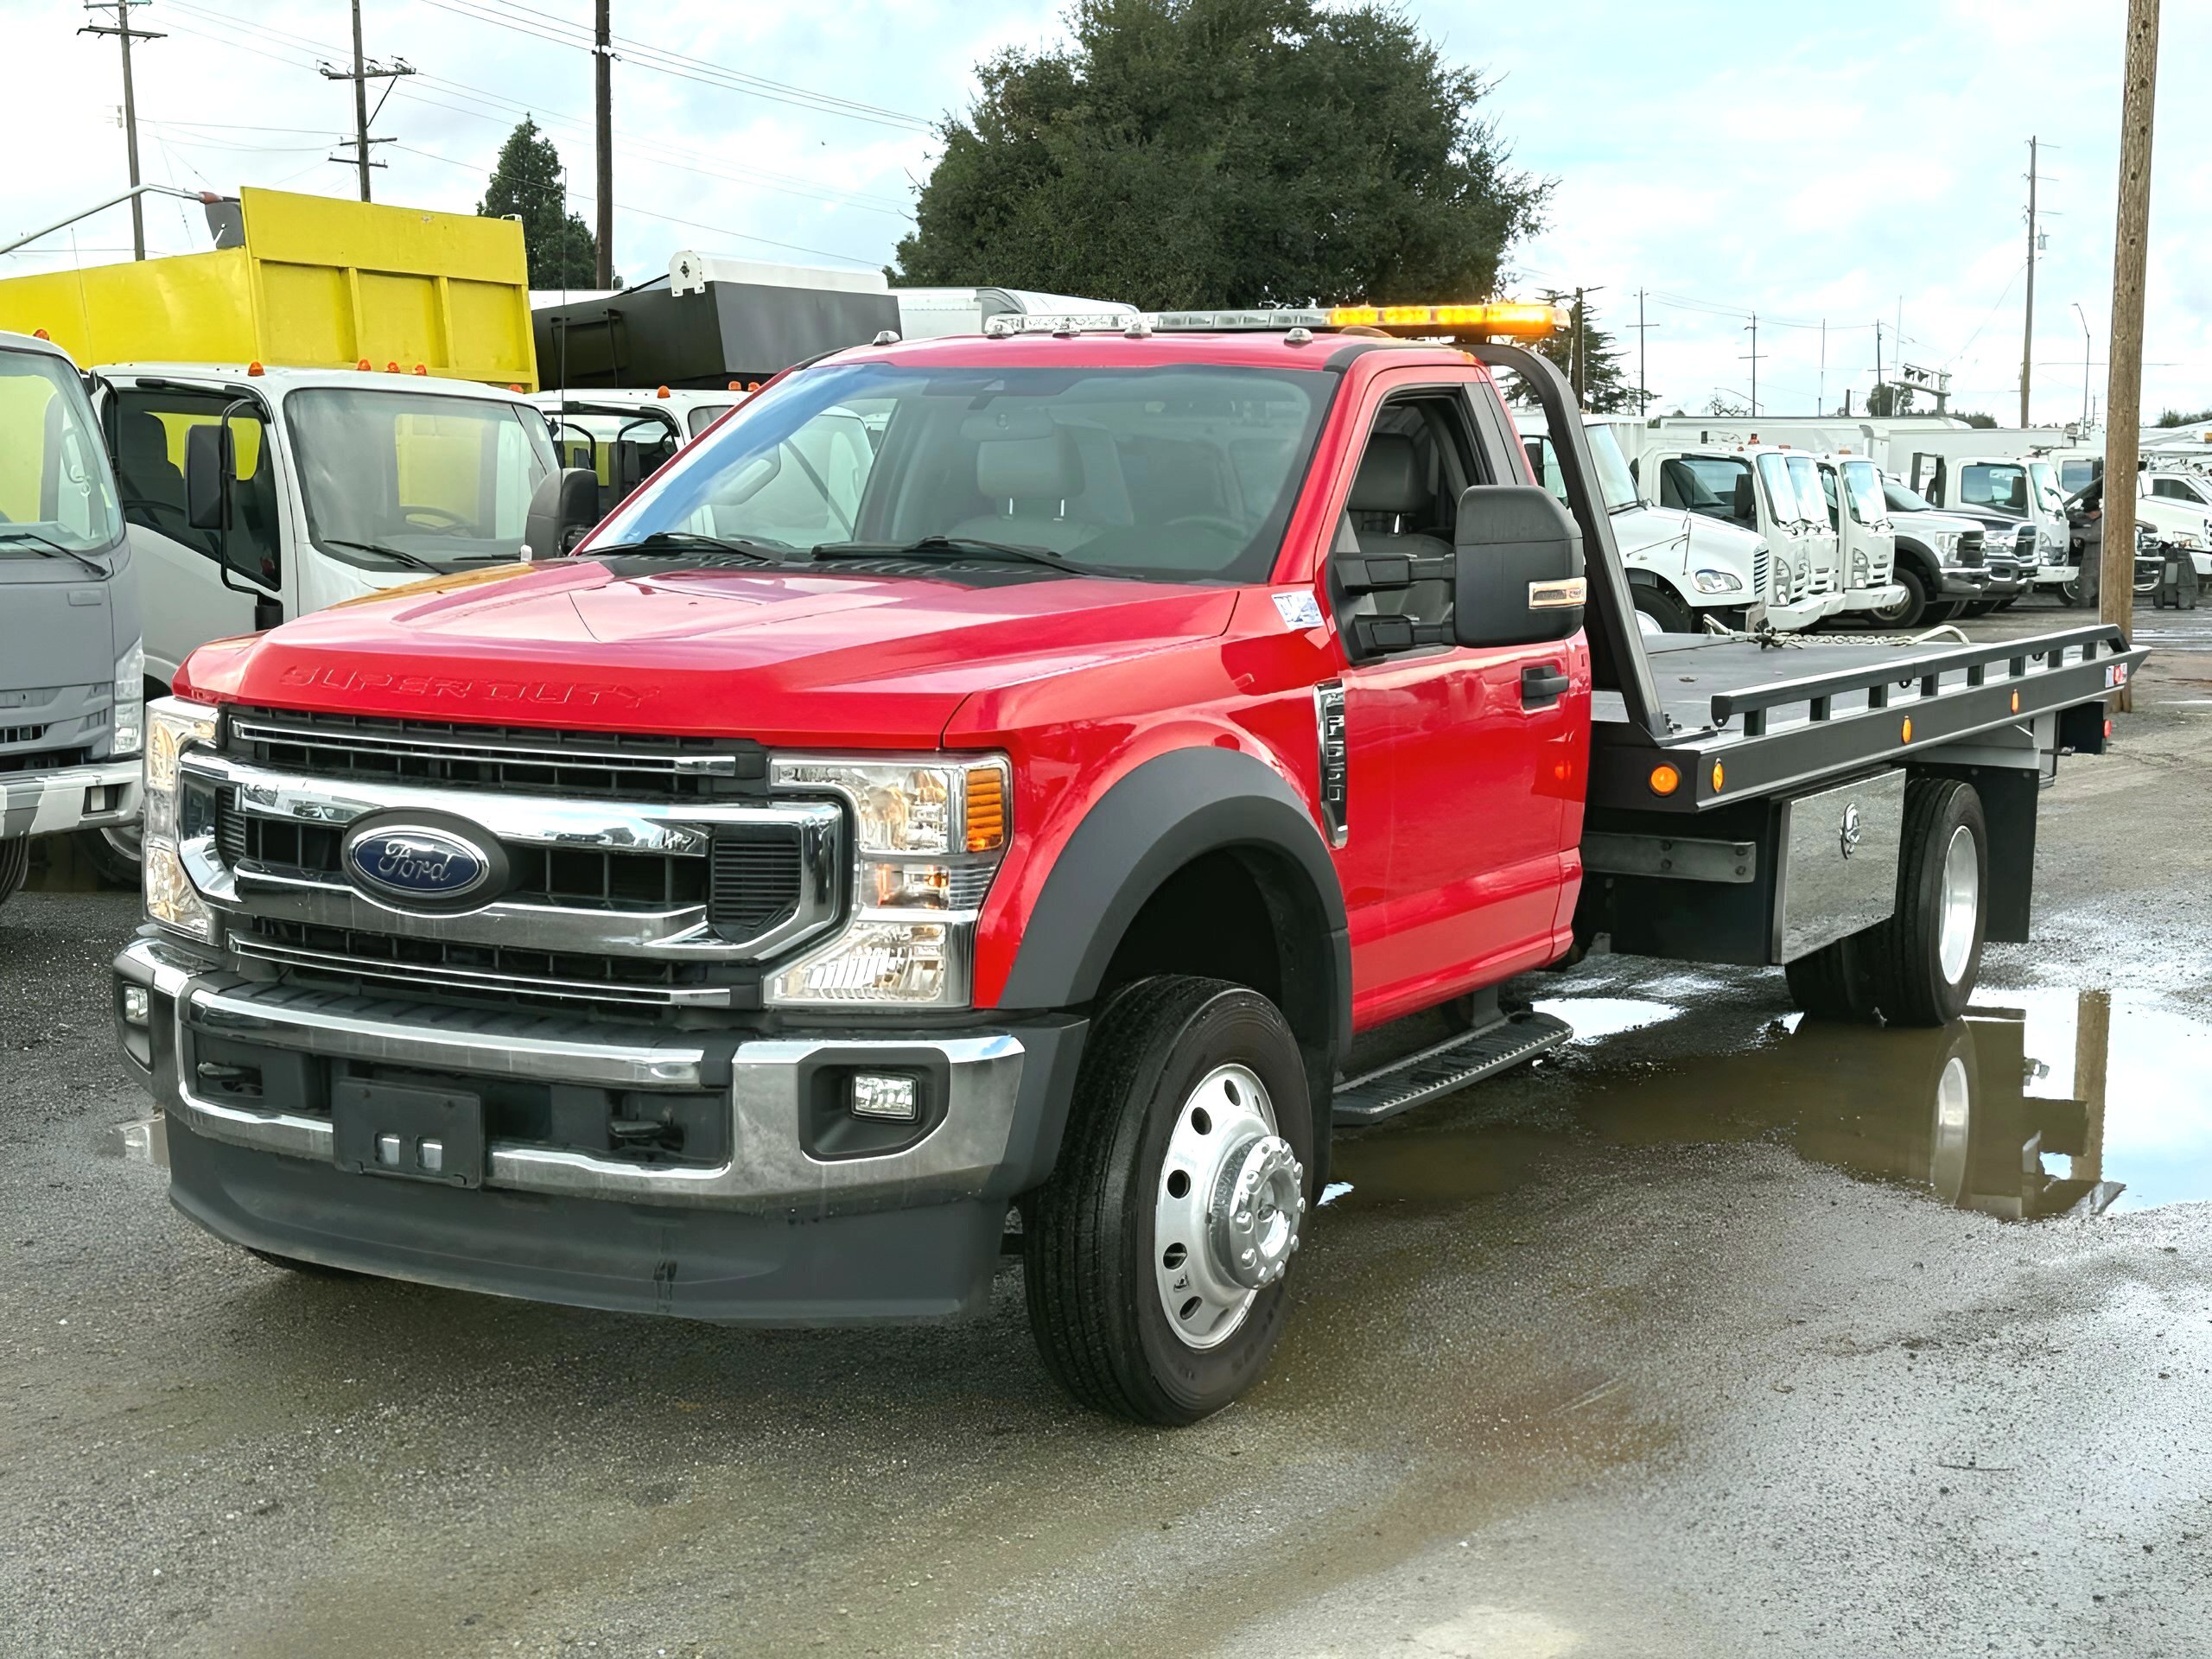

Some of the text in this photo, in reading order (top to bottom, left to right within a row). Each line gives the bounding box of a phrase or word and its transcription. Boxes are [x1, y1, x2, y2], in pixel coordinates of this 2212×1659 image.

[279, 664, 662, 709] SUPER DUTY
[378, 839, 452, 881] Ford
